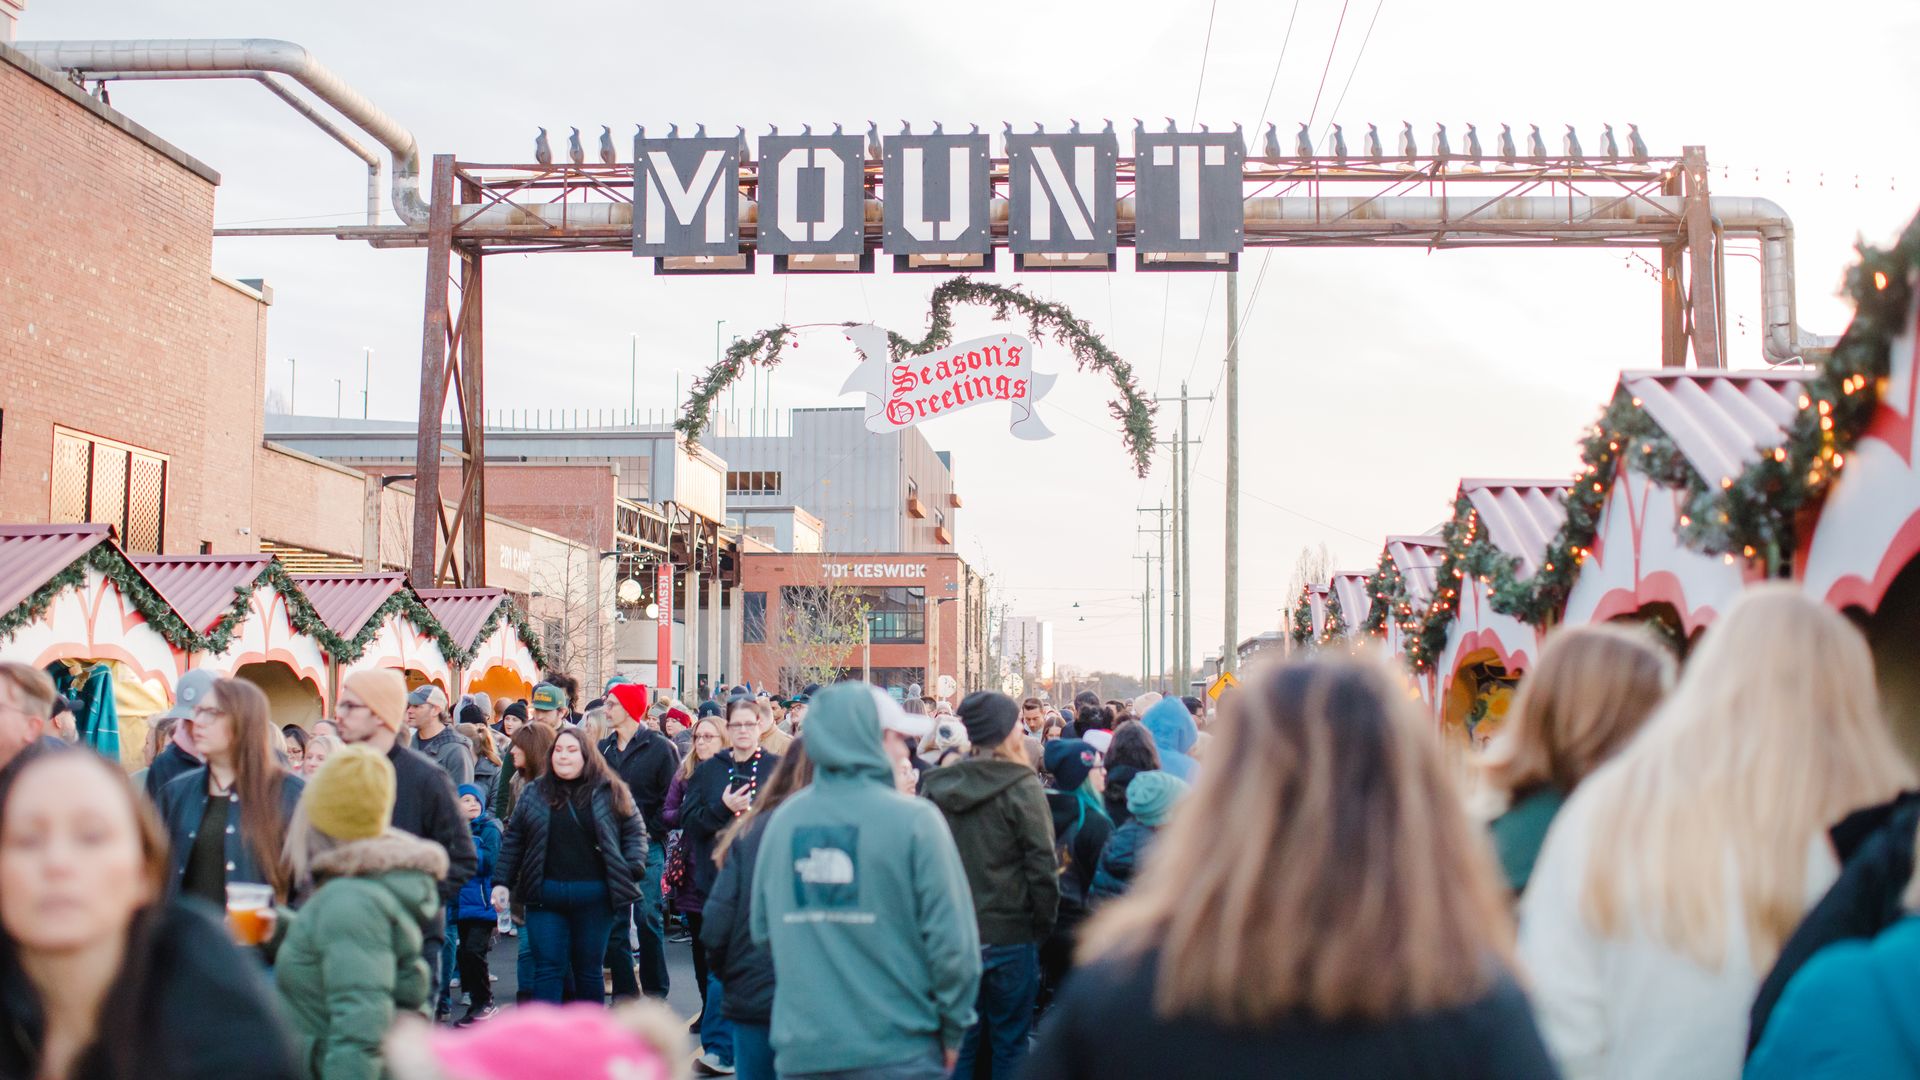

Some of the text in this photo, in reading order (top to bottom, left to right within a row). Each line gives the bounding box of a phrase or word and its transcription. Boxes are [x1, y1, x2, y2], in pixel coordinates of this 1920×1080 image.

[645, 145, 1225, 244] MOUNT
[892, 337, 1023, 398] Season's
[886, 374, 1028, 426] Greetings
[822, 563, 926, 578] 701 KESWICK
[659, 575, 669, 626] KESWICK
